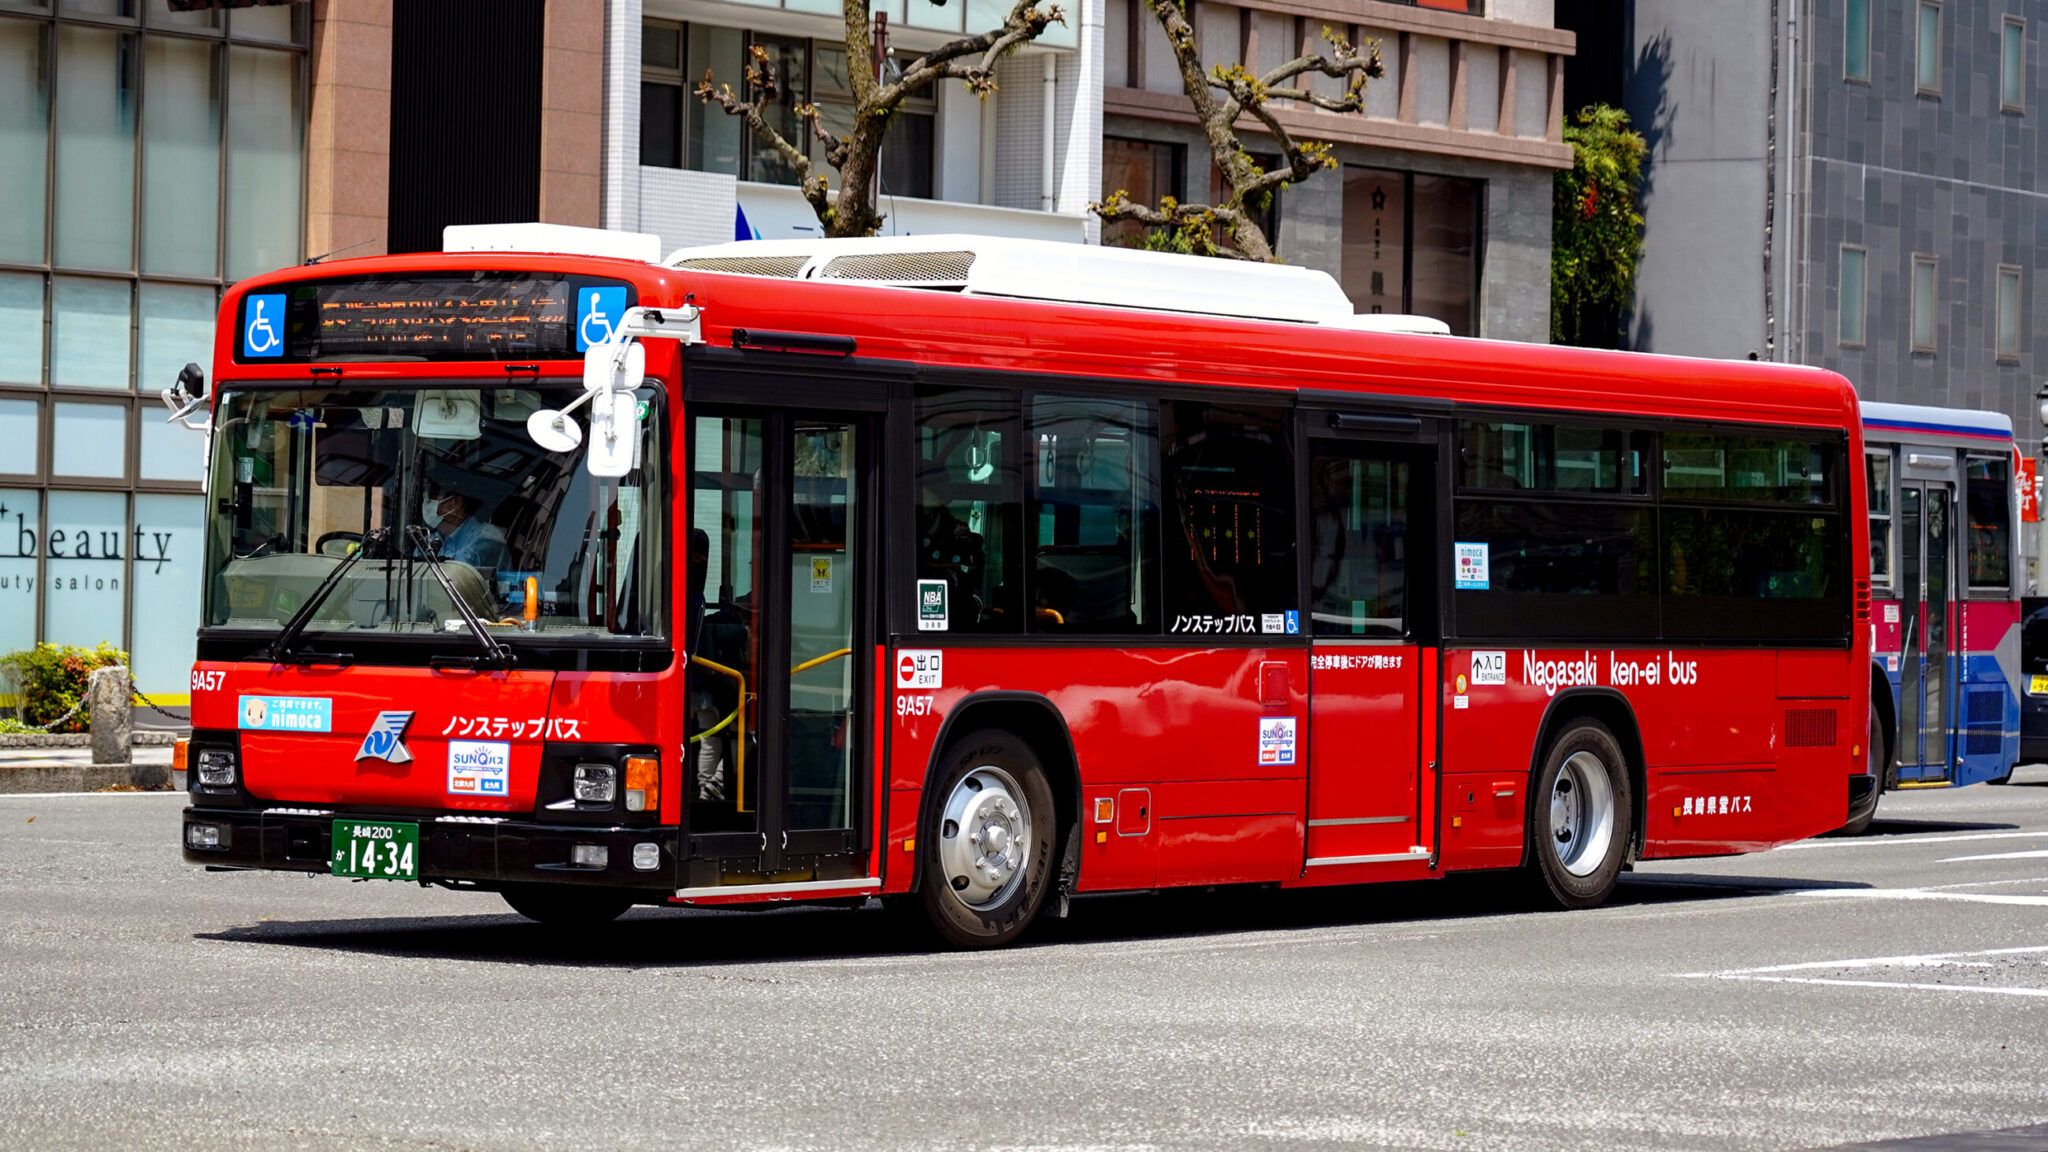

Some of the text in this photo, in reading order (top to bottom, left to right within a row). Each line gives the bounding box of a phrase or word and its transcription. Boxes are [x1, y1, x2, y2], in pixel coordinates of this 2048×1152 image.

[16, 512, 172, 575] beauty
[1460, 546, 1483, 557] nimoca
[54, 574, 119, 591] salon
[923, 591, 942, 605] NBA
[1170, 614, 1256, 633] ノンステップバス
[916, 654, 940, 671] 出口
[1484, 655, 1503, 670] 入口
[191, 670, 227, 691] 9A57
[918, 674, 937, 685] EXIT
[1481, 672, 1505, 682] ENTRANCE
[1523, 649, 1698, 697] Nagasaki ken-ei bus
[896, 695, 934, 716] 9A57
[271, 709, 322, 729] nimoca
[442, 715, 582, 739] ノンステップバス
[1683, 795, 1752, 816] 長崎県営バス
